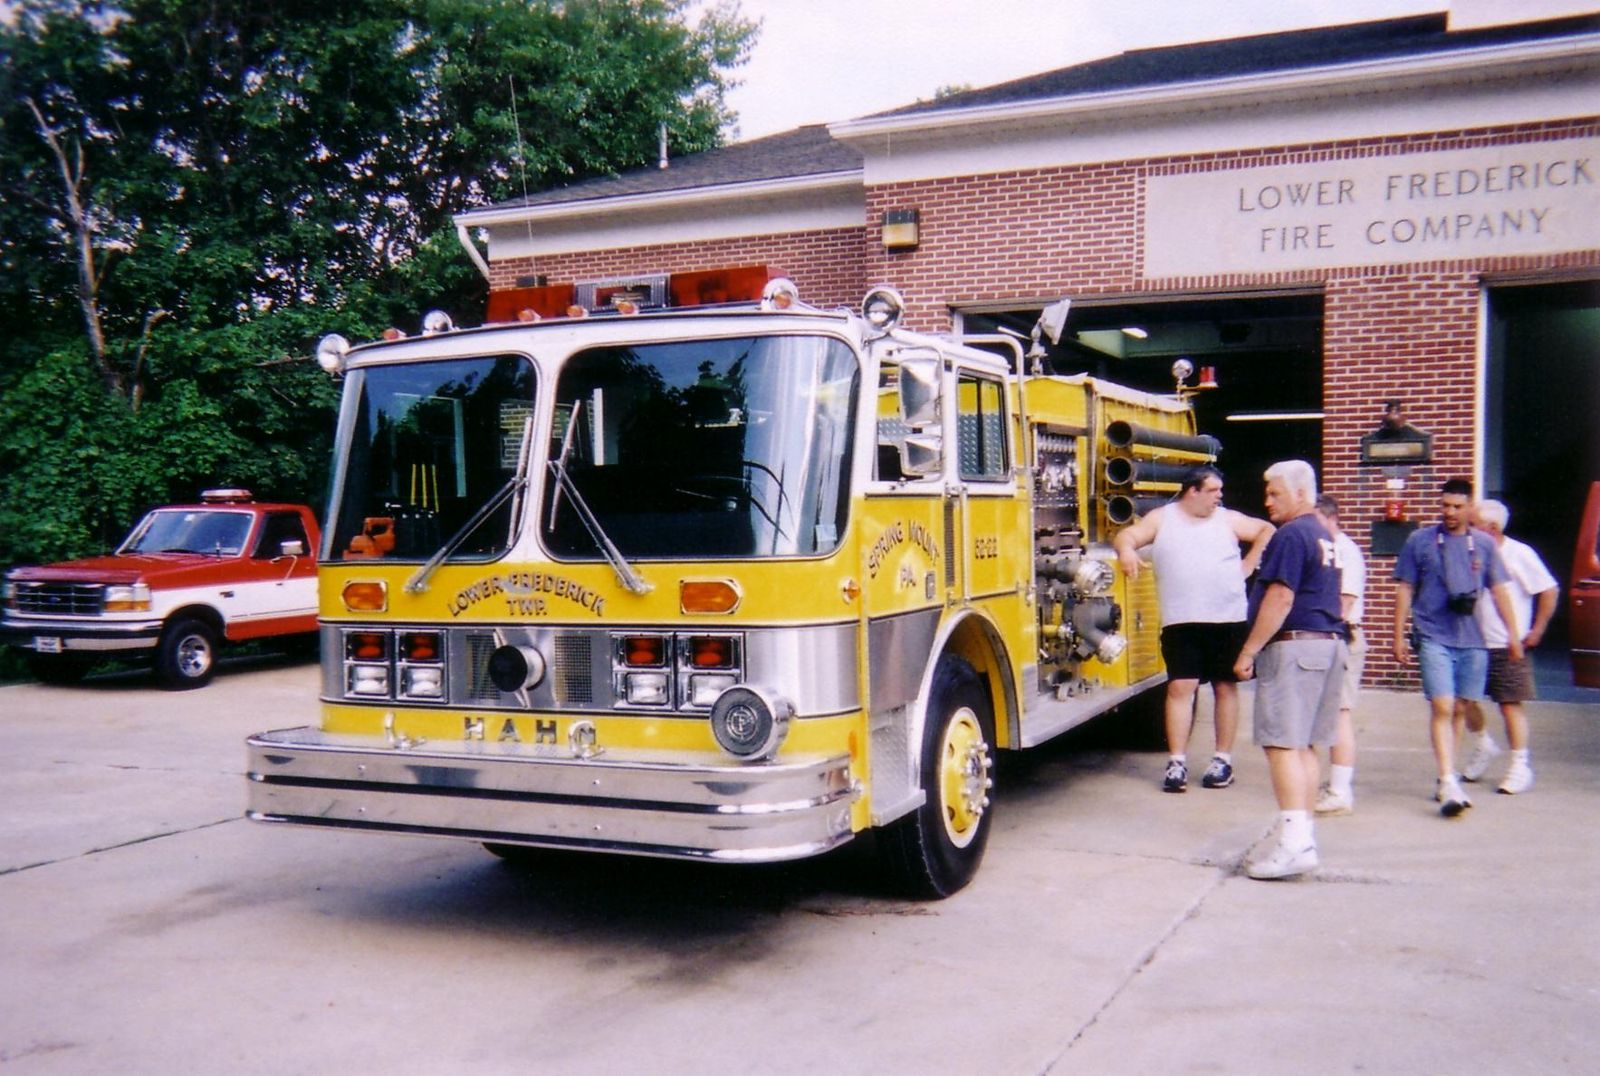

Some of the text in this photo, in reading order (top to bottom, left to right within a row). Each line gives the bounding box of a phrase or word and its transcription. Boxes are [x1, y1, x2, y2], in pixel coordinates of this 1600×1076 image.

[1239, 158, 1594, 212] LOWER FREDERICK
[1261, 208, 1549, 252] FIRE COMPANY
[869, 521, 903, 579] SPRING
[448, 572, 604, 617] LOWER FREDERICK
[506, 599, 547, 616] TWP.
